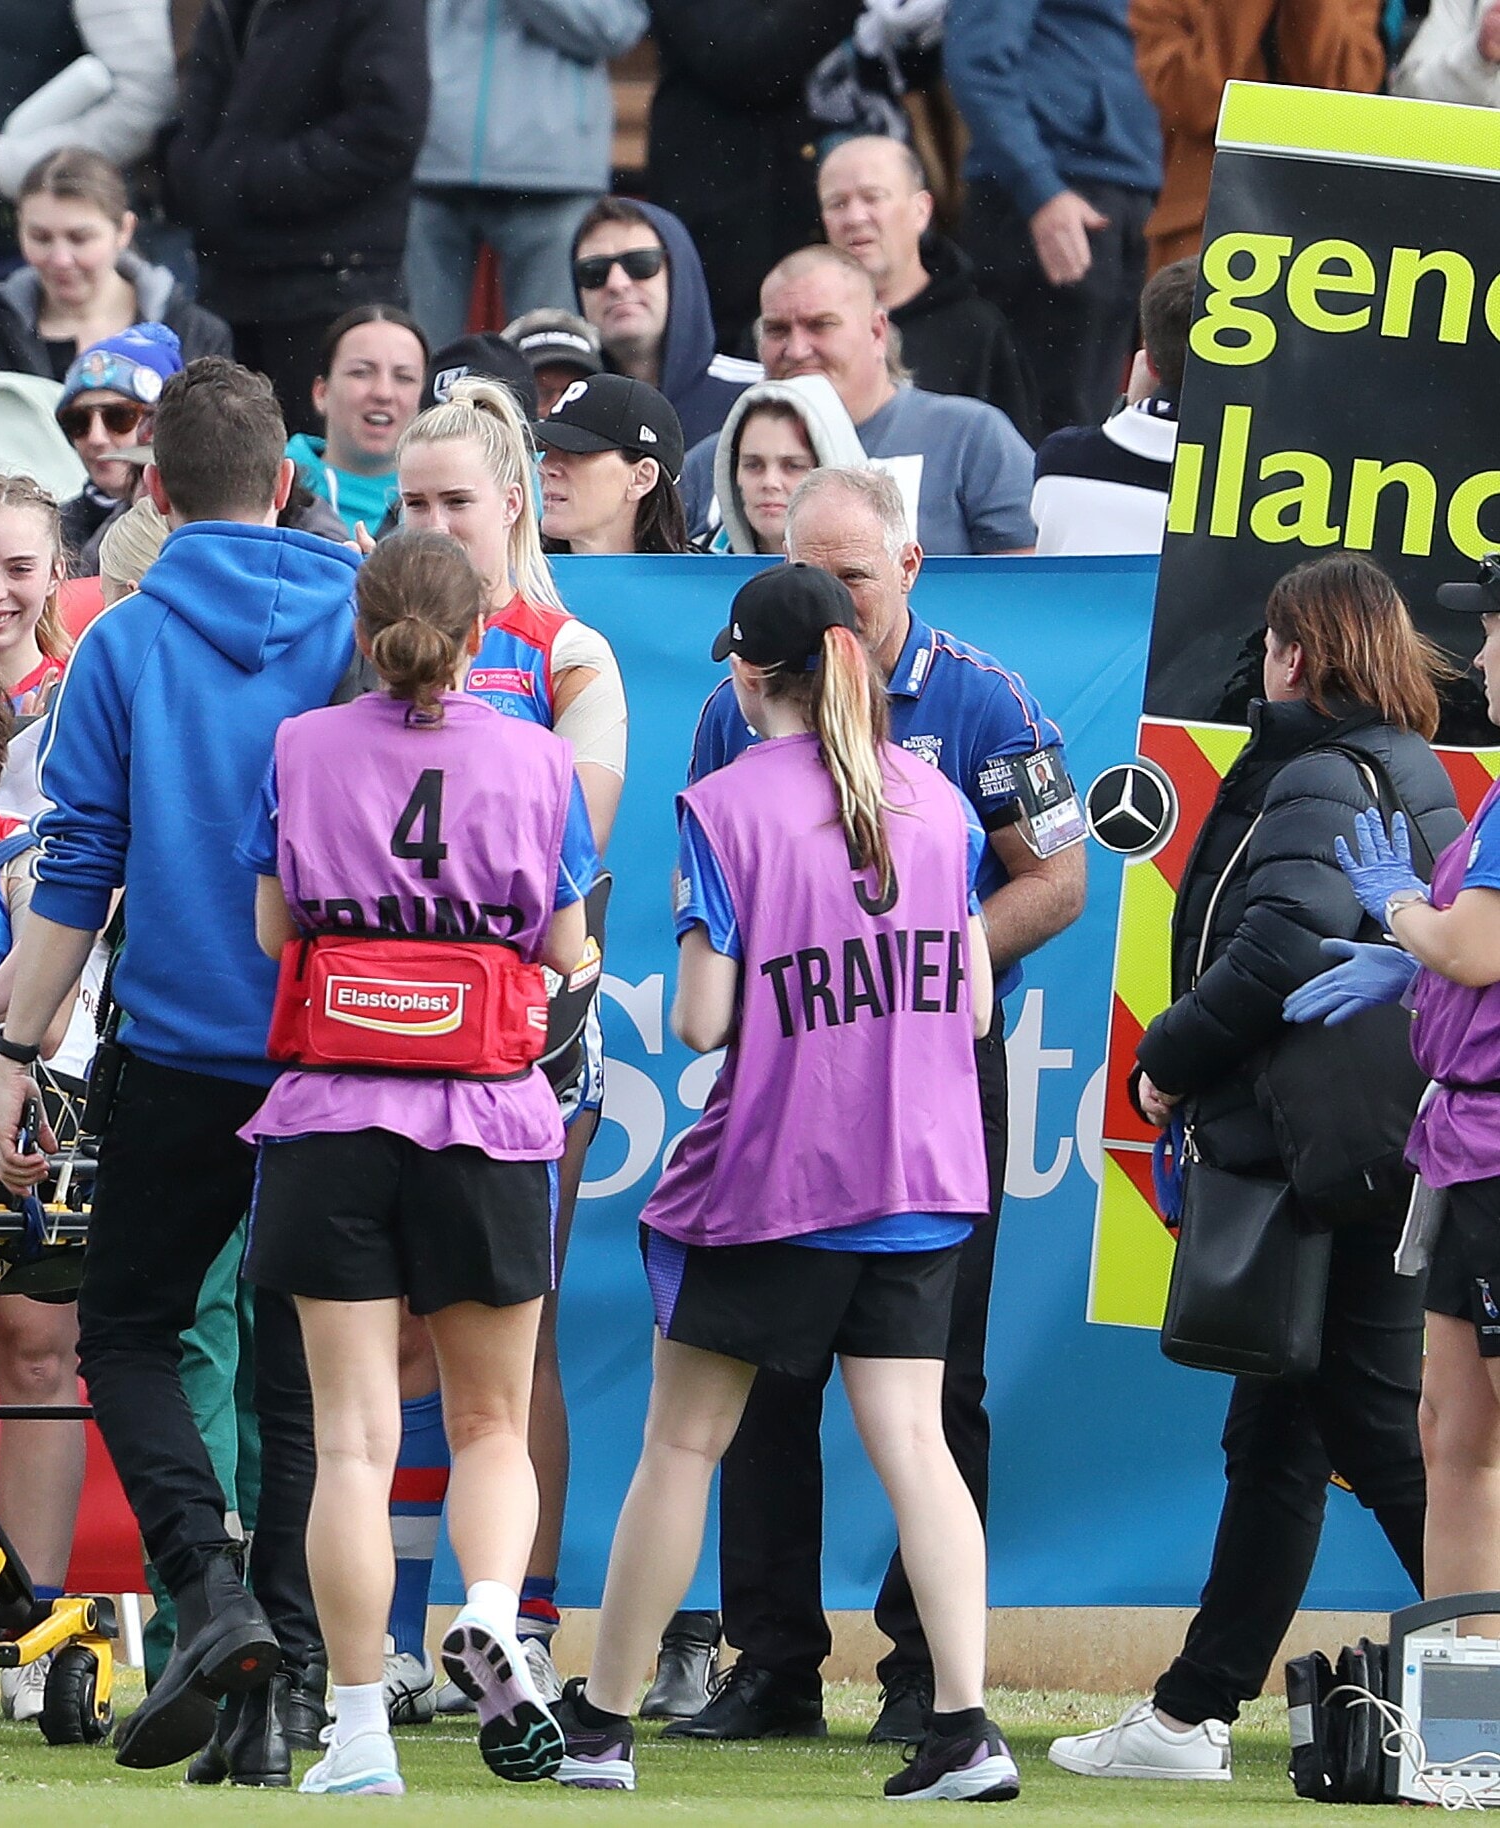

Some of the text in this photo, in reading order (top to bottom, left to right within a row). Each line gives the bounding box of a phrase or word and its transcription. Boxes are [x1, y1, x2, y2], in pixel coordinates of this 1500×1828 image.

[1189, 232, 1500, 366] gen
[551, 380, 588, 414] P
[390, 769, 448, 879] 4
[337, 988, 451, 1012] Elastoplast
